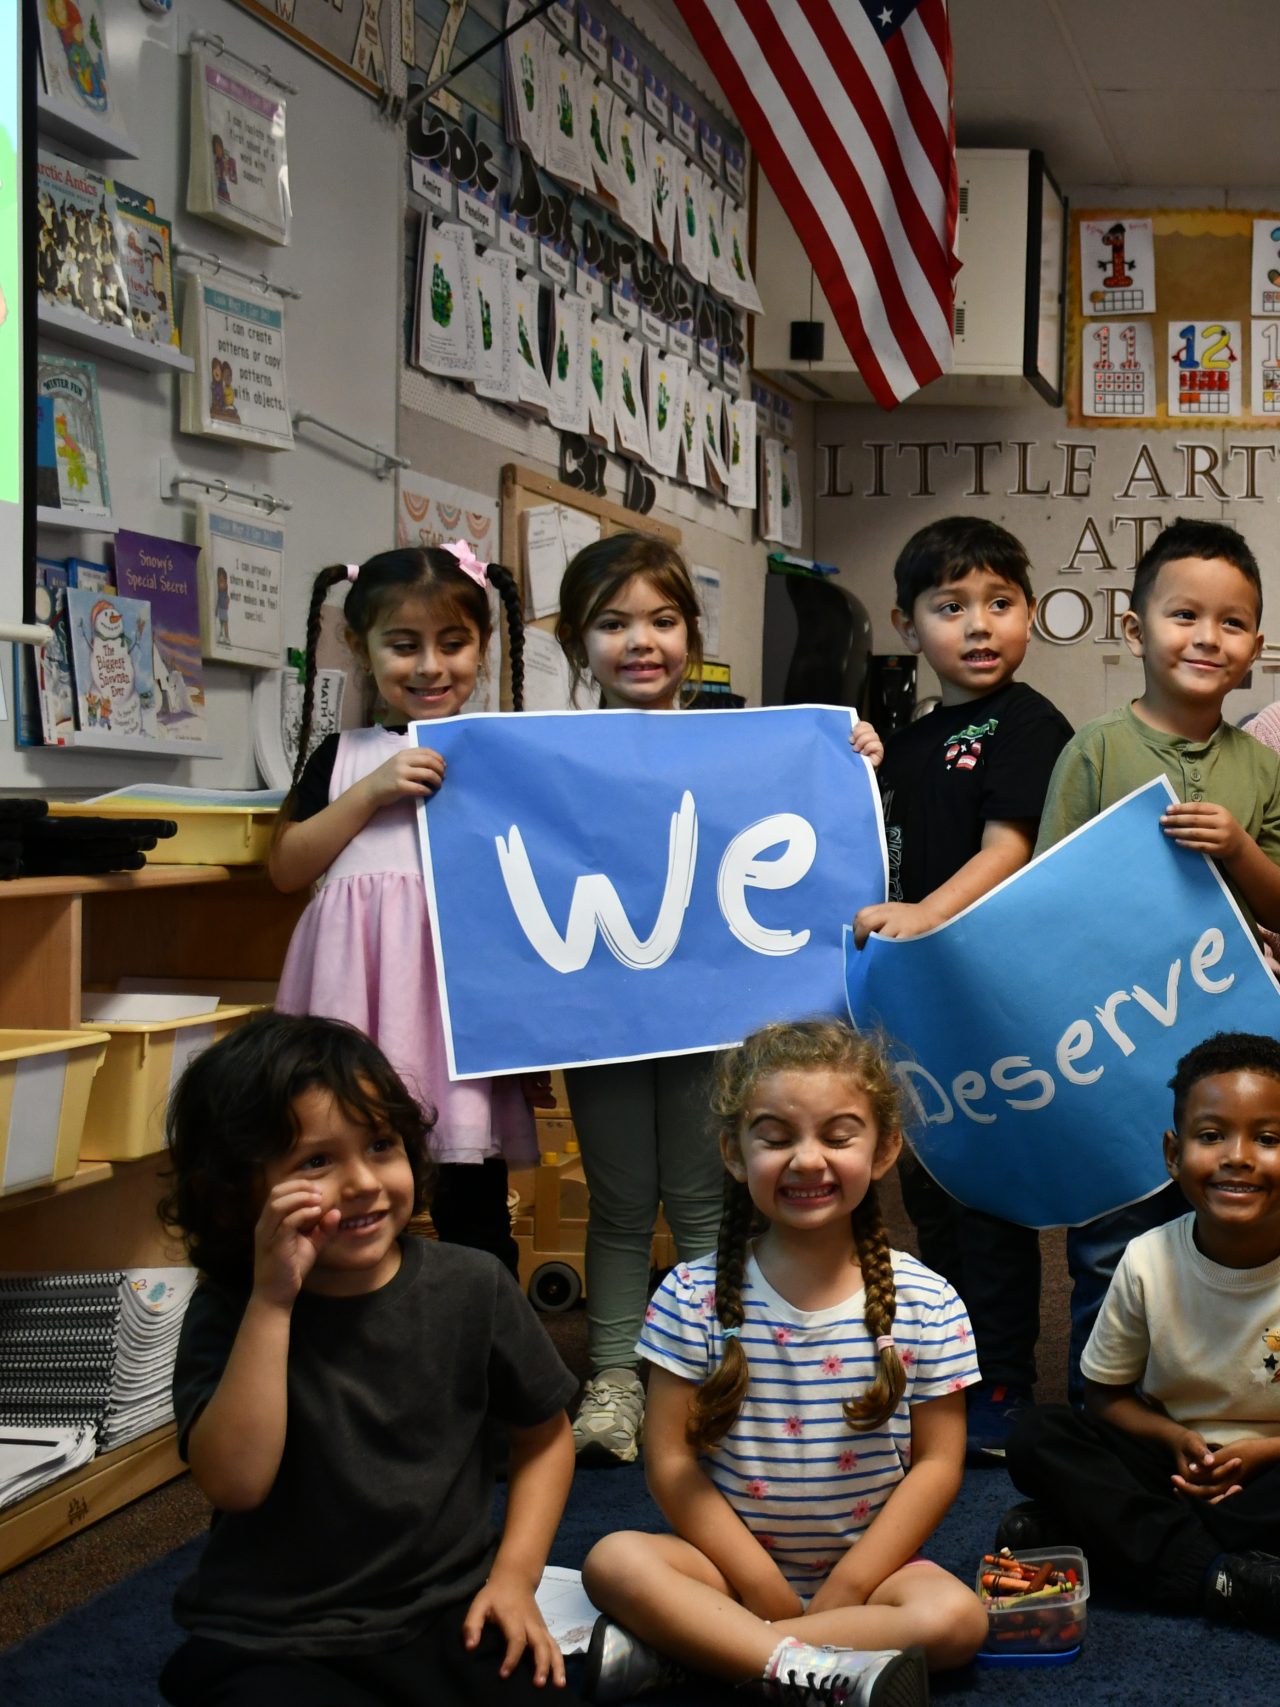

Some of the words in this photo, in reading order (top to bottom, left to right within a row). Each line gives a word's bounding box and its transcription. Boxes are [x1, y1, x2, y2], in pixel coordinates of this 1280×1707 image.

[65, 170, 98, 197] Antics
[1103, 223, 1133, 288] 1
[232, 322, 245, 337] can
[248, 327, 273, 345] create
[1179, 325, 1232, 369] 12
[218, 339, 250, 360] patterns
[252, 350, 262, 362] or
[264, 353, 281, 370] copy
[1093, 326, 1140, 370] 11
[43, 378, 69, 391] WINTER
[70, 382, 84, 397] FUN
[239, 367, 273, 387] patterns
[234, 386, 250, 402] with
[253, 391, 286, 412] objects.
[819, 440, 1098, 499] LITTLE
[1060, 516, 1162, 571] AT
[138, 550, 174, 573] Snowy's
[126, 568, 157, 591] Special
[159, 576, 188, 595] Secret
[103, 644, 115, 657] The
[96, 655, 126, 674] Biggest
[99, 672, 131, 688] Snowman
[111, 686, 125, 697] Ever
[321, 678, 331, 717] MATH
[495, 790, 817, 973] We
[895, 927, 1235, 1127] Deserve
